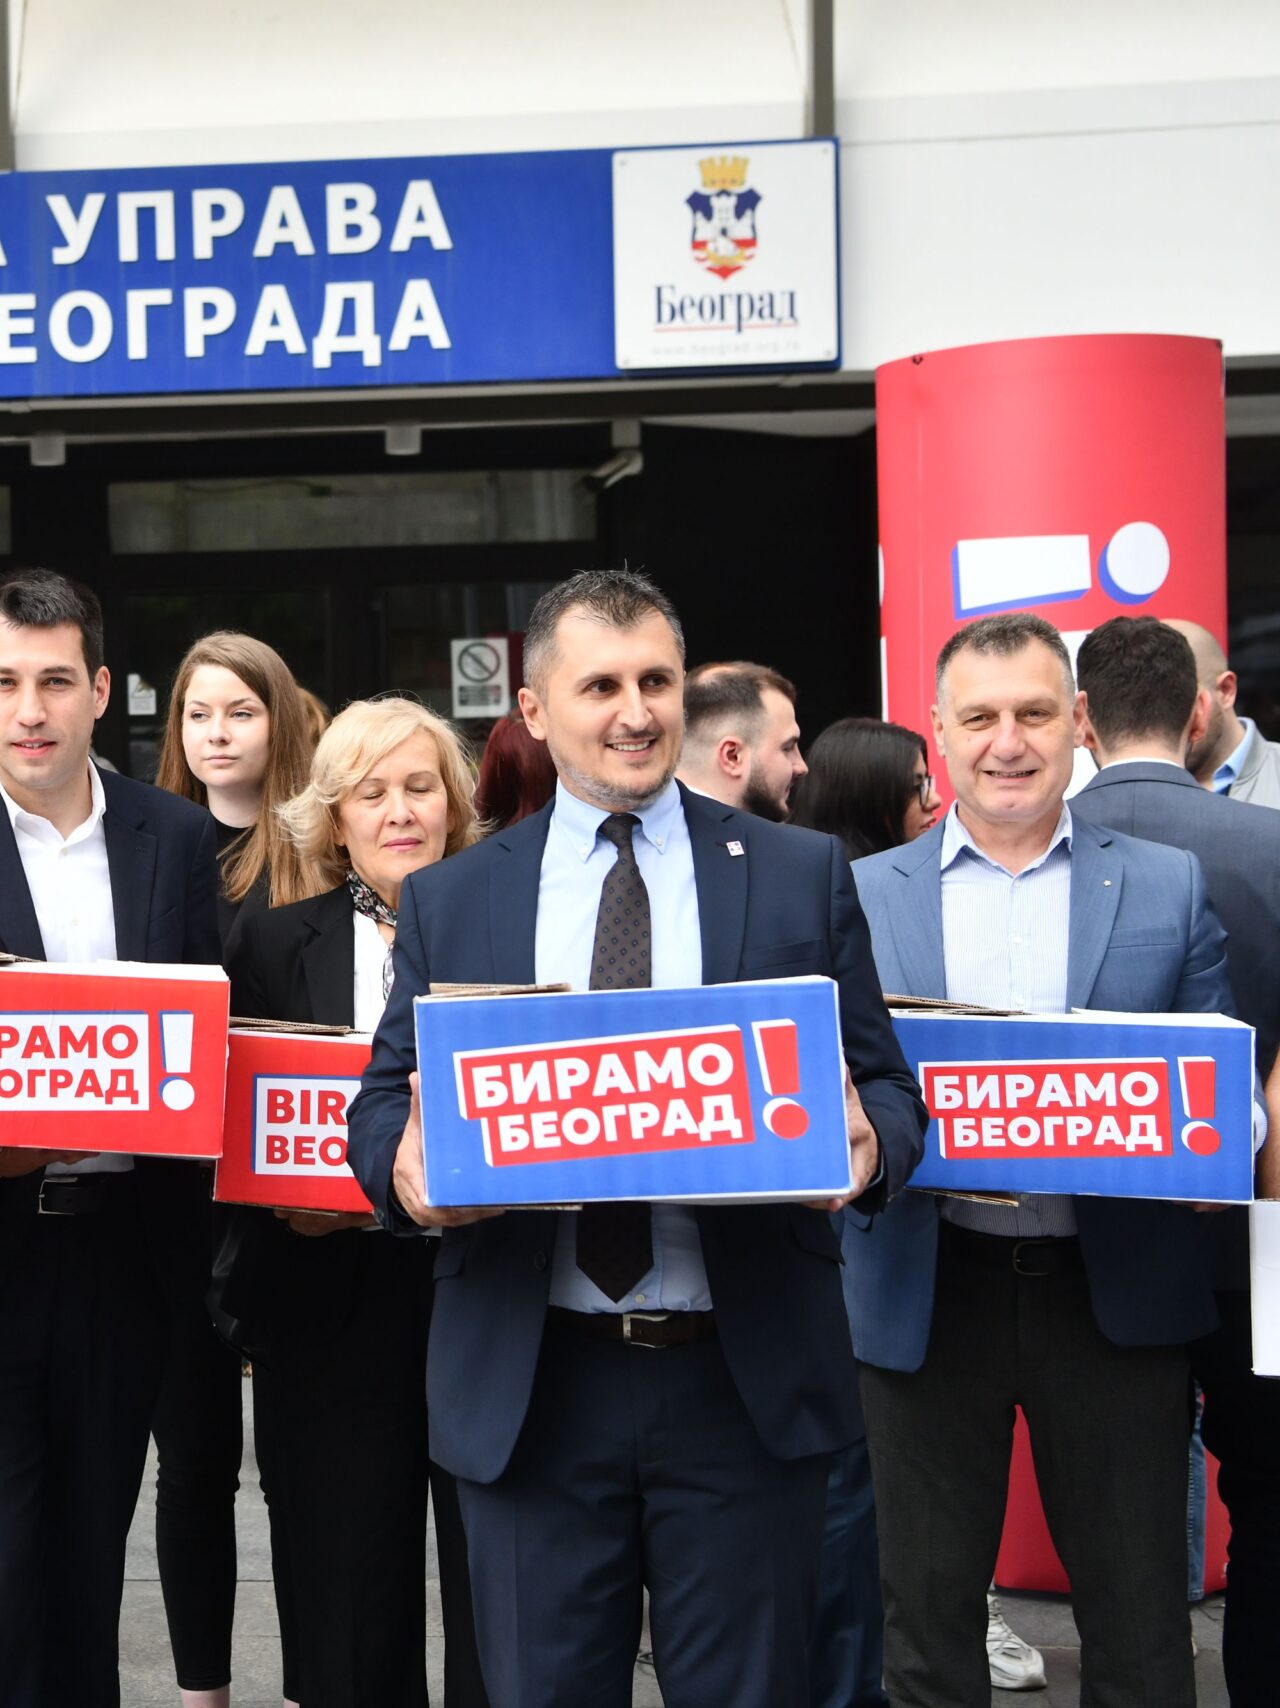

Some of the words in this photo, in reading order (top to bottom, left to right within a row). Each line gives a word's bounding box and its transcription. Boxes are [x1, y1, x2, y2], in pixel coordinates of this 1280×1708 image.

[46, 180, 453, 264] УПРАВА
[655, 285, 799, 333] Београд
[471, 1042, 734, 1109] БИРАМО
[933, 1071, 1159, 1110] БИРАМО
[267, 1088, 348, 1126] BIR
[497, 1094, 744, 1152] БЕОГРАД
[266, 1135, 348, 1167] BEO
[953, 1115, 1163, 1153] БЕОГРАД
